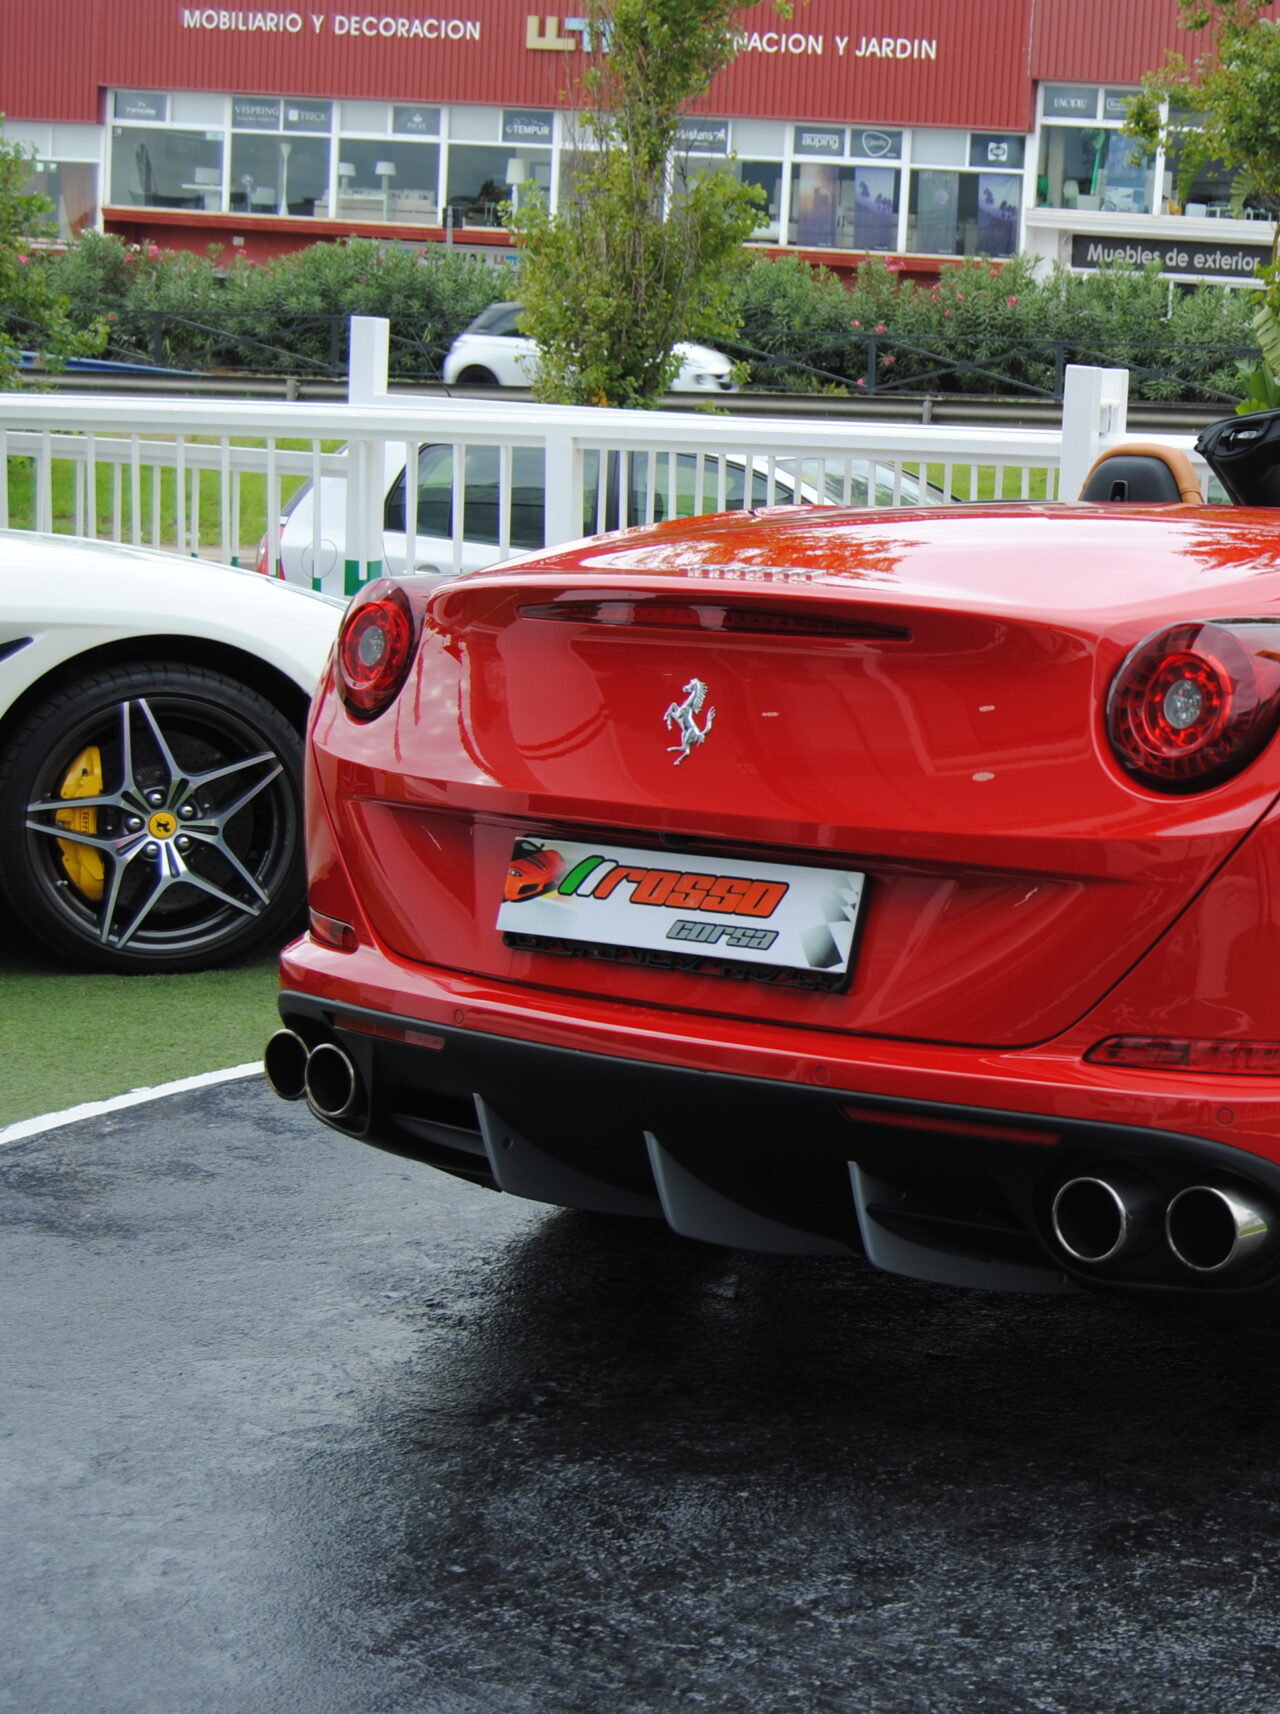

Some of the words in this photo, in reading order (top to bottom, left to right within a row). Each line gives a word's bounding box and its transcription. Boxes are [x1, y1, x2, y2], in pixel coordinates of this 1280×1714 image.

[183, 9, 302, 33] MOBILIARIO
[311, 14, 325, 34] Y
[334, 16, 481, 40] DECORACION
[835, 35, 849, 56] Y
[855, 36, 938, 60] JARDIN
[235, 105, 279, 116] VISPRING
[513, 124, 550, 136] TEMPUR
[801, 133, 840, 149] auping
[1086, 243, 1161, 265] Muebles
[1165, 248, 1189, 267] de
[1193, 251, 1262, 271] exterior
[665, 919, 780, 951] corsa
